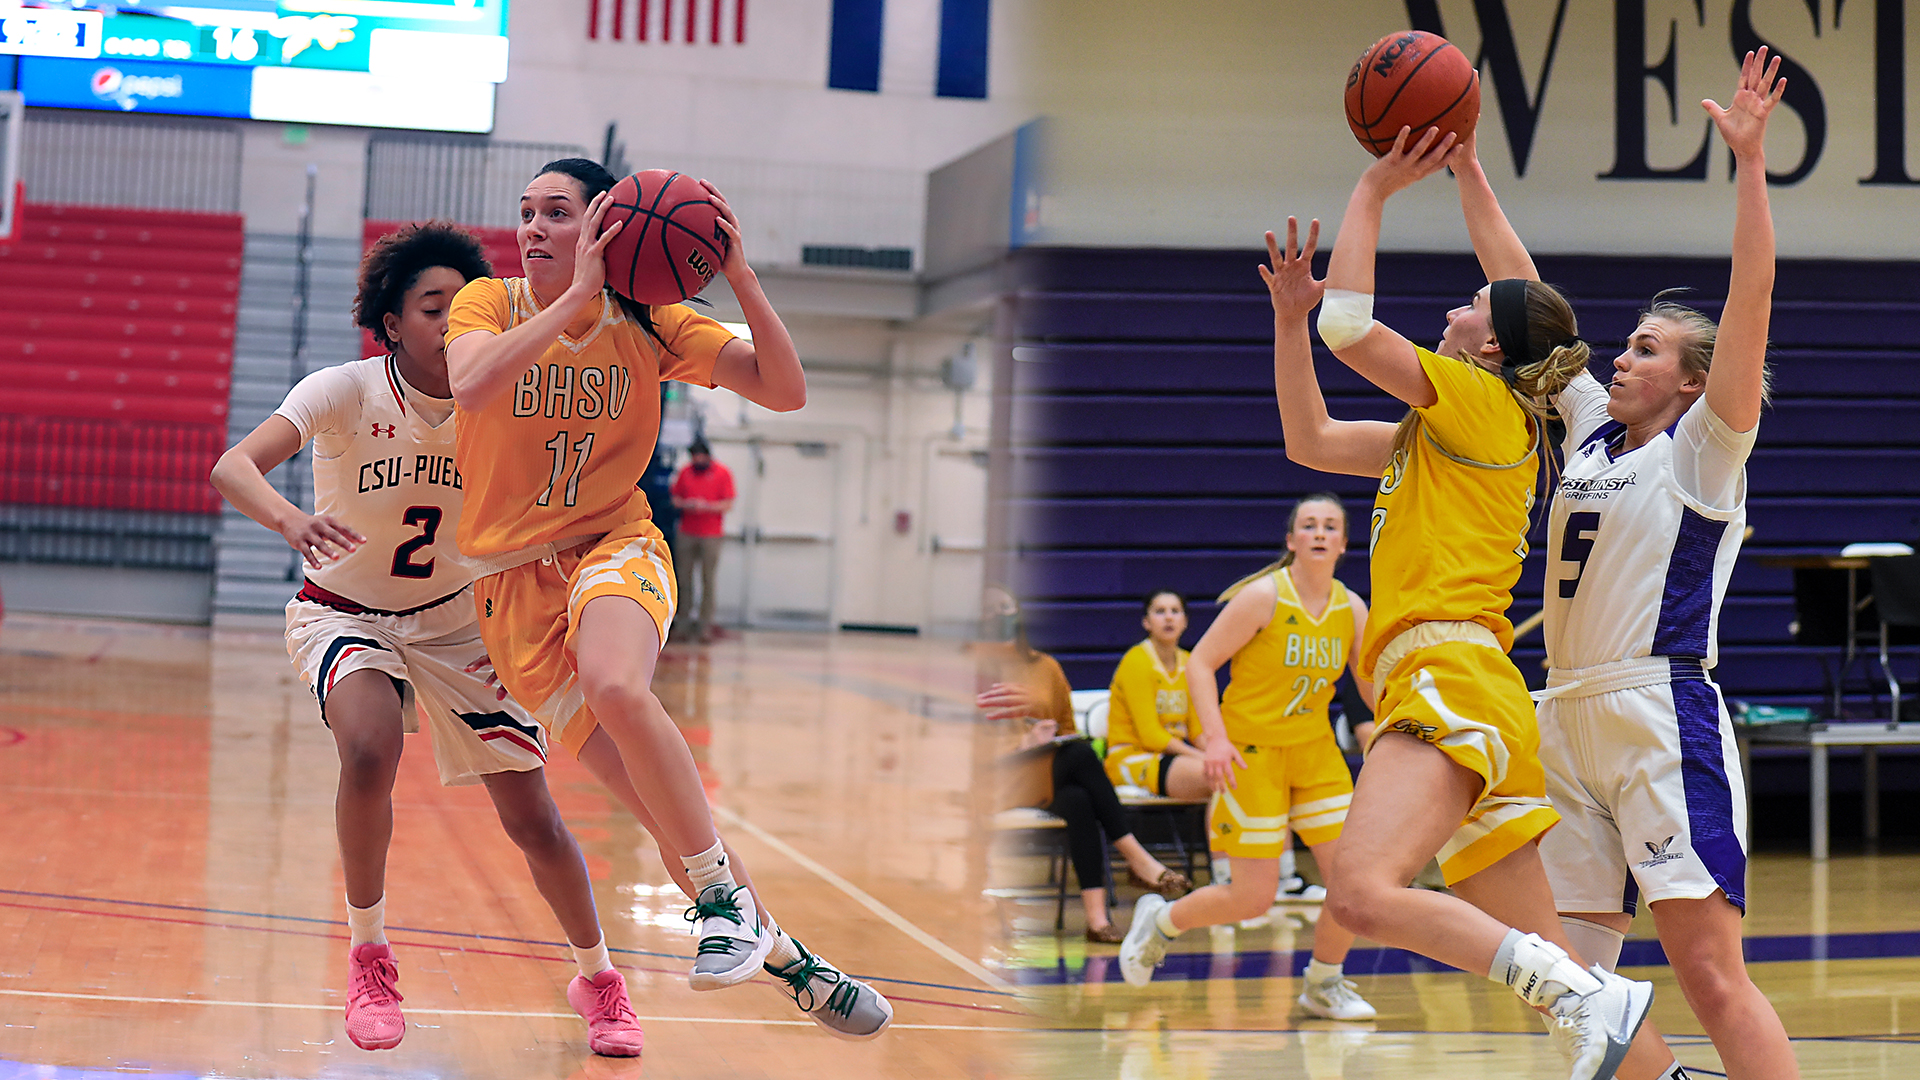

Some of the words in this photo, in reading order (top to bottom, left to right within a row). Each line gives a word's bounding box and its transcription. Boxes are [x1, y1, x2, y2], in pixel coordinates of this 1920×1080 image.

[213, 26, 259, 61] 16
[1374, 32, 1425, 78] NCAA
[1405, 0, 1920, 186] WEST
[536, 431, 595, 507] 11
[1564, 491, 1610, 501] GRIFFINS
[390, 505, 443, 579] 2
[1284, 633, 1342, 670] BHSU
